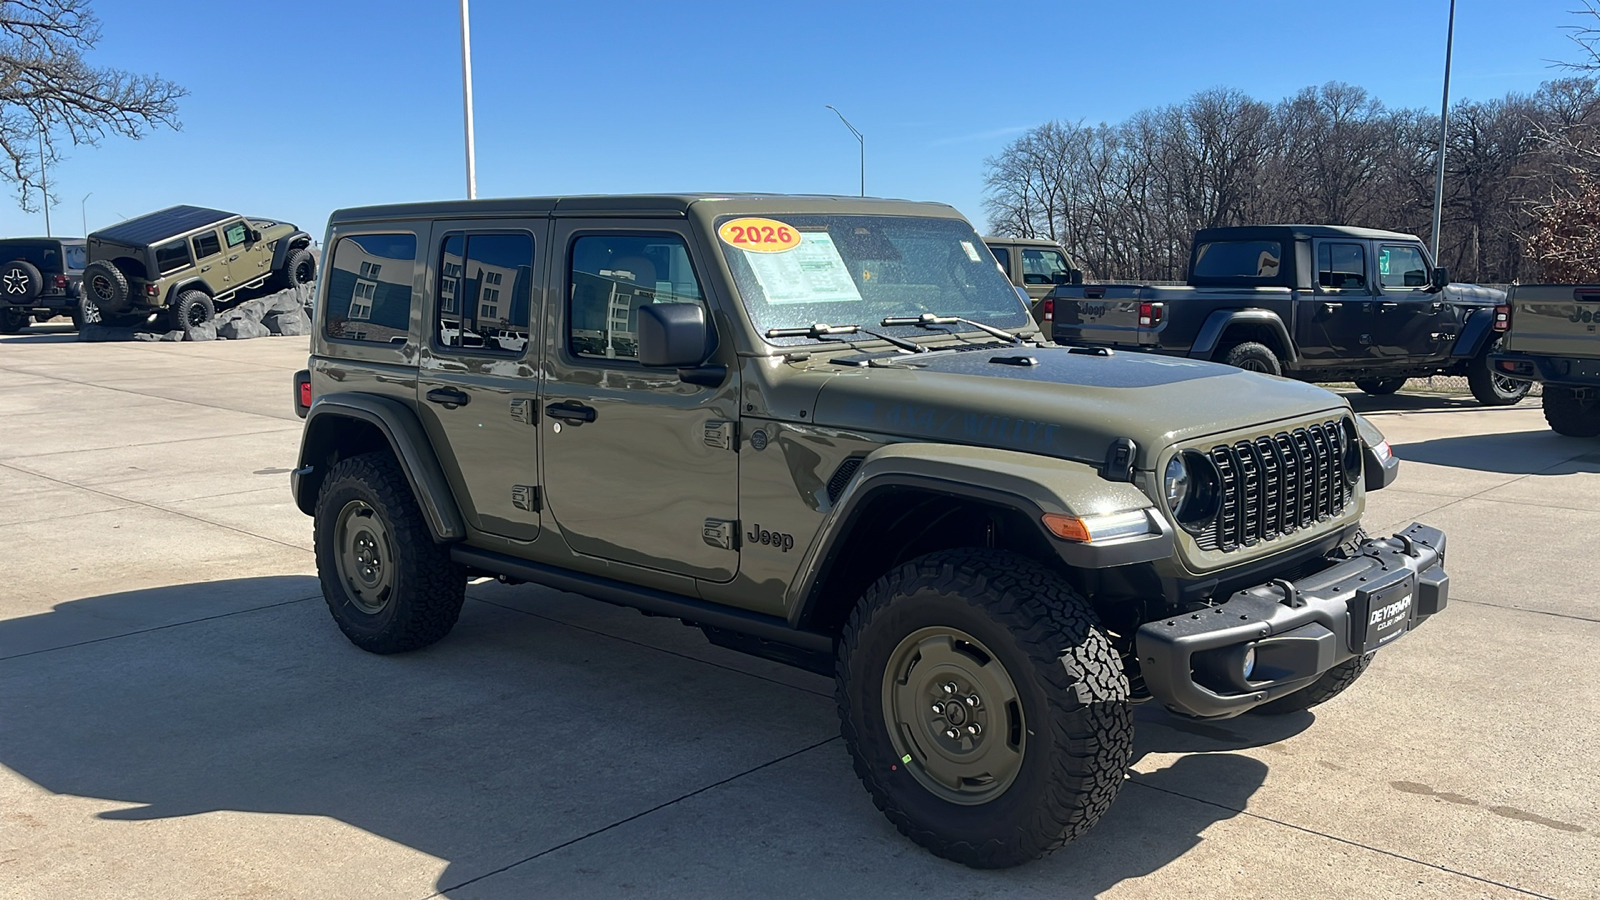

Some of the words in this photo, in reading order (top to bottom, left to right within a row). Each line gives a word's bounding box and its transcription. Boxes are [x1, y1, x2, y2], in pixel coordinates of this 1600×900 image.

[730, 225, 792, 244] 2026
[1081, 302, 1106, 318] Jeep
[747, 523, 794, 553] Jeep
